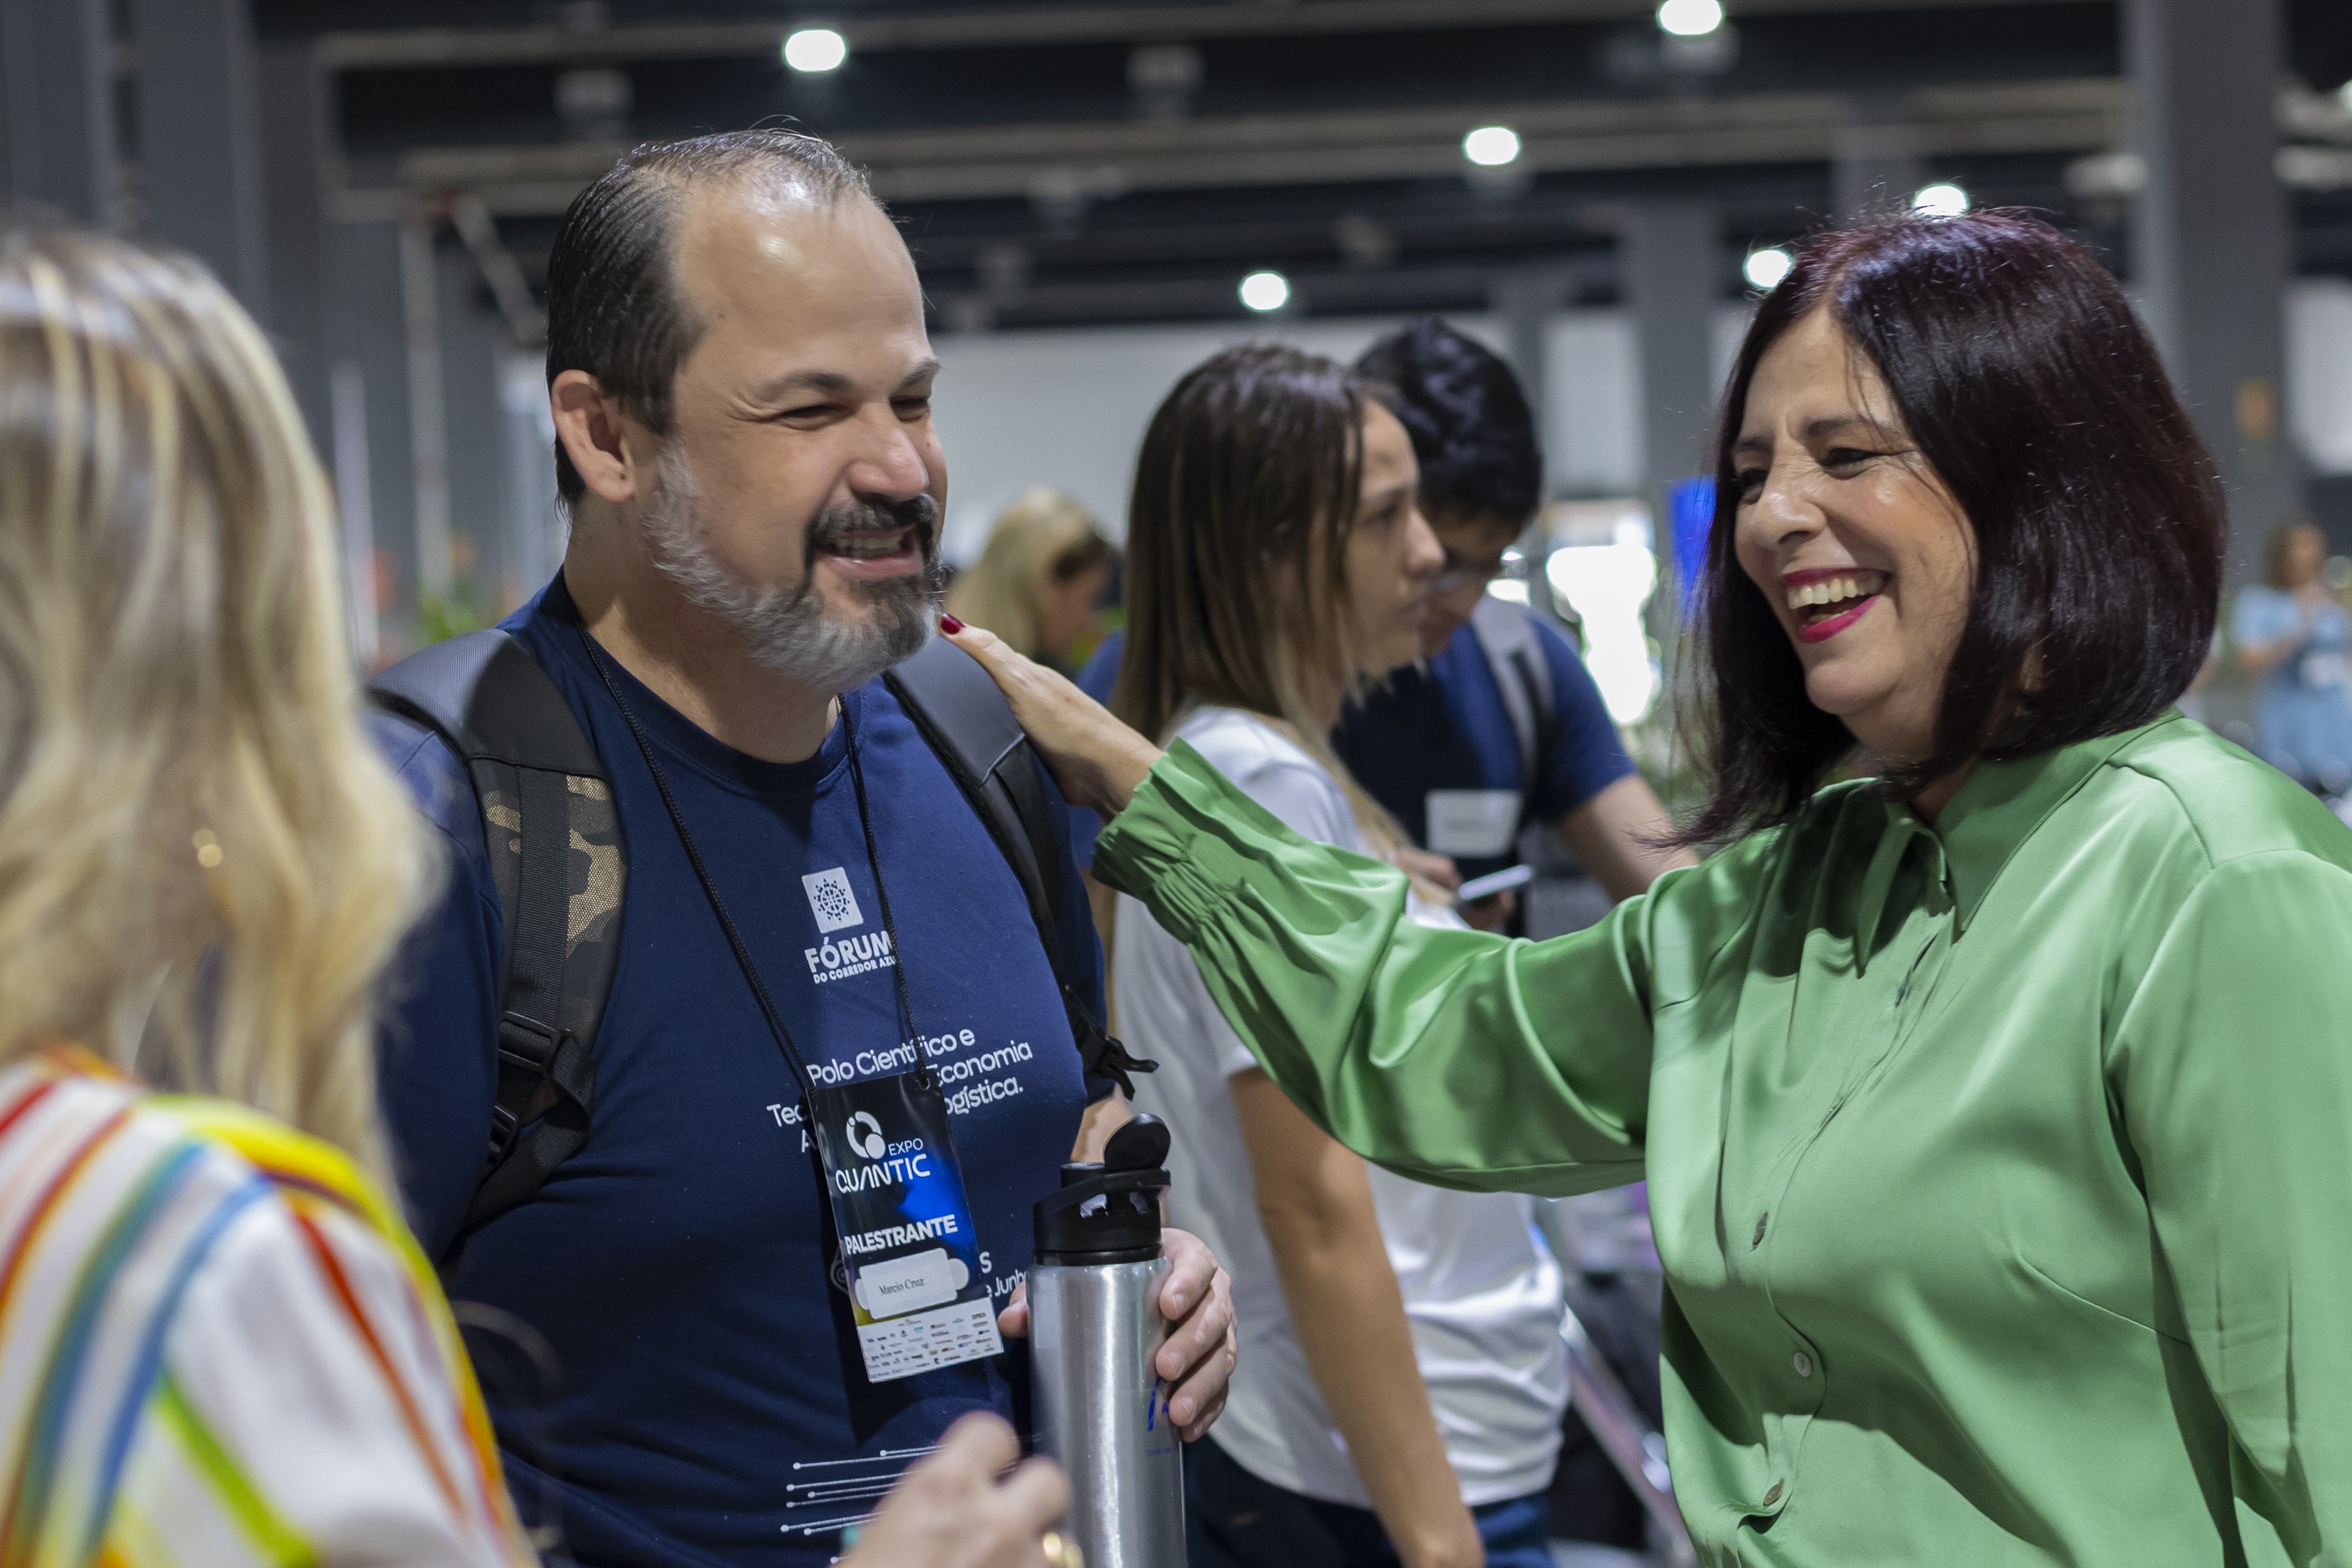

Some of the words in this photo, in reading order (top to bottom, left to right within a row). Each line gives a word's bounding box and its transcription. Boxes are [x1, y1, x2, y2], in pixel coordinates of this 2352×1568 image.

[804, 930, 893, 973] FÓRUM
[813, 972, 828, 984] DO
[828, 959, 878, 981] CORREDOR
[879, 955, 900, 968] AZU
[806, 1058, 854, 1086] Polo
[856, 1034, 957, 1075] Cientíico
[959, 1028, 975, 1047] e
[944, 1076, 1024, 1115] ogística.
[888, 1138, 923, 1156] EXPO
[835, 1154, 931, 1193] QUANTIC
[844, 1214, 958, 1255] PALESTRANTE
[904, 1278, 926, 1289] Cruz
[994, 1268, 1027, 1298] Junh
